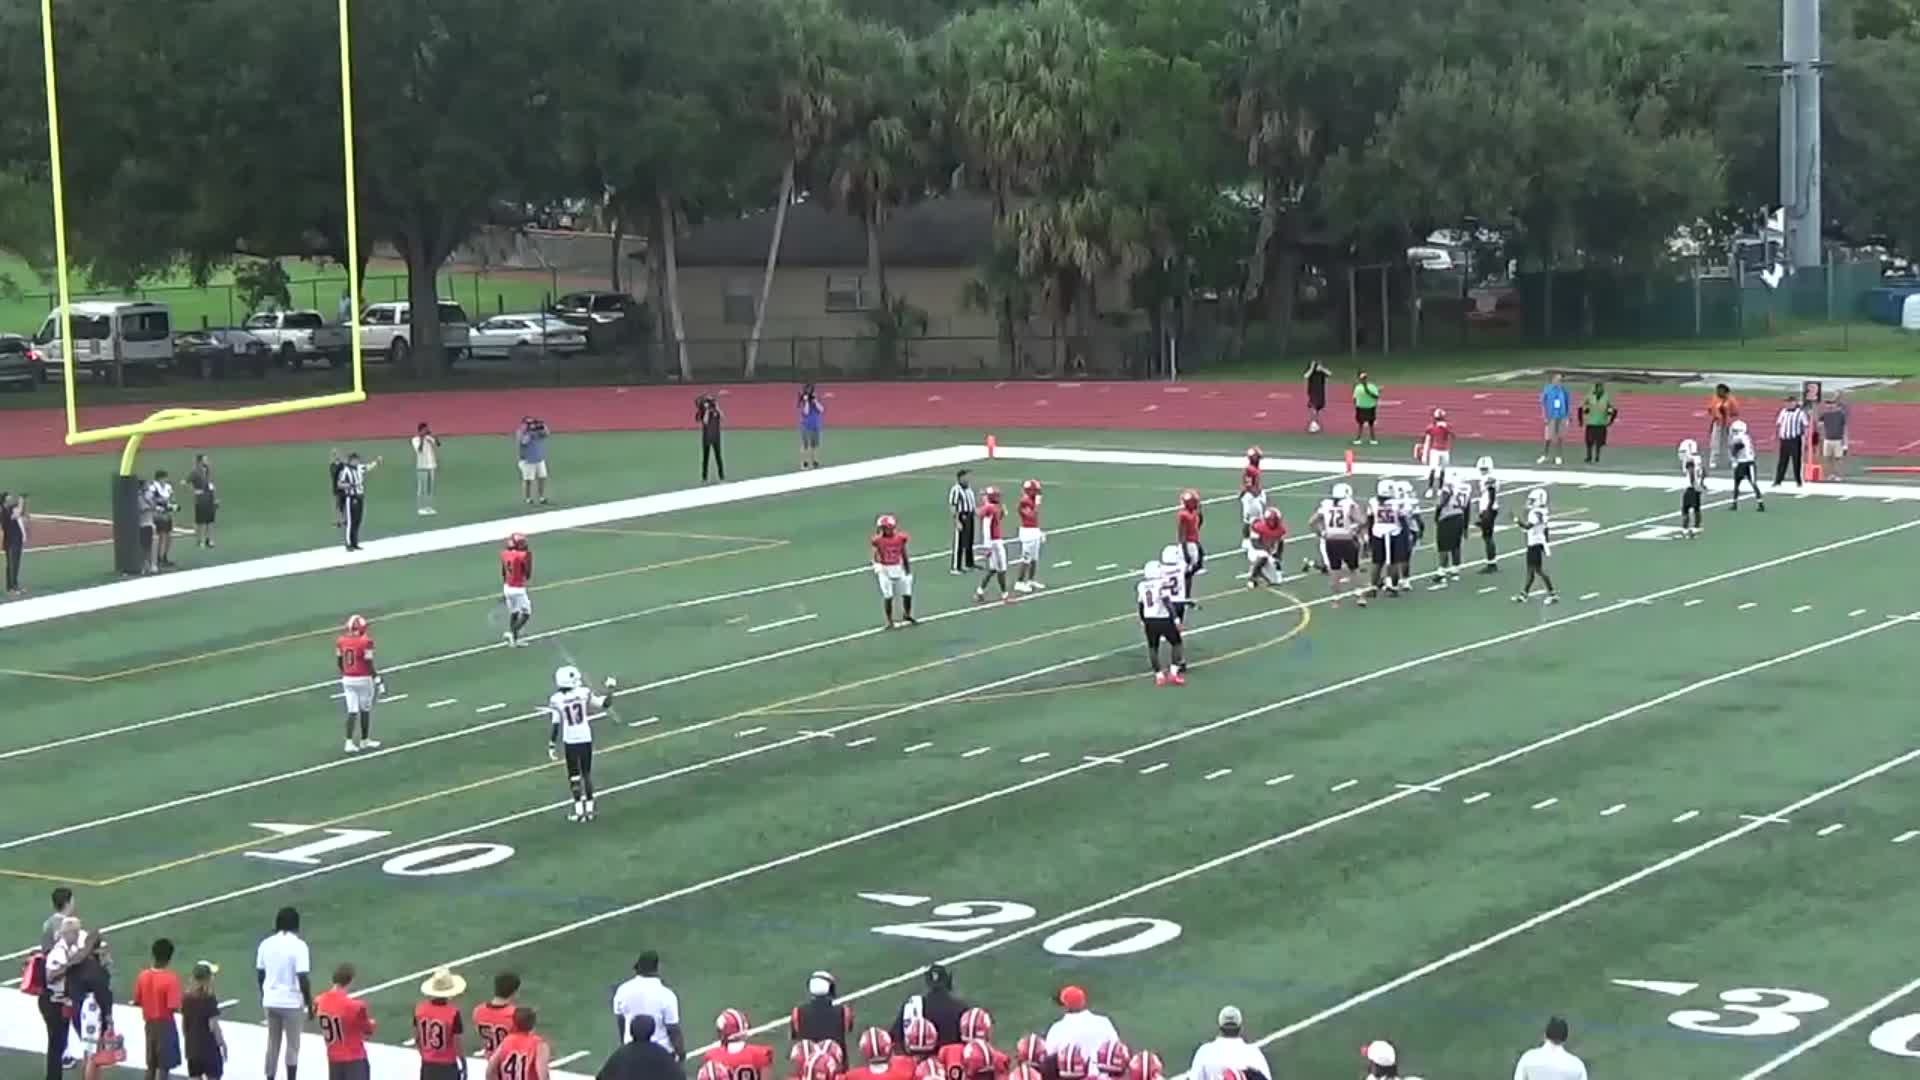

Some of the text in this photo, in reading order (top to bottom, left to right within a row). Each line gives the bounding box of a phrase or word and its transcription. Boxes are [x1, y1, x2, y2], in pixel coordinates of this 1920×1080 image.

[1328, 510, 1344, 529] 72
[564, 703, 583, 727] 13
[870, 900, 1183, 957] 20
[319, 1014, 343, 1043] 91
[420, 1019, 444, 1050] 13
[503, 1052, 527, 1080] 41
